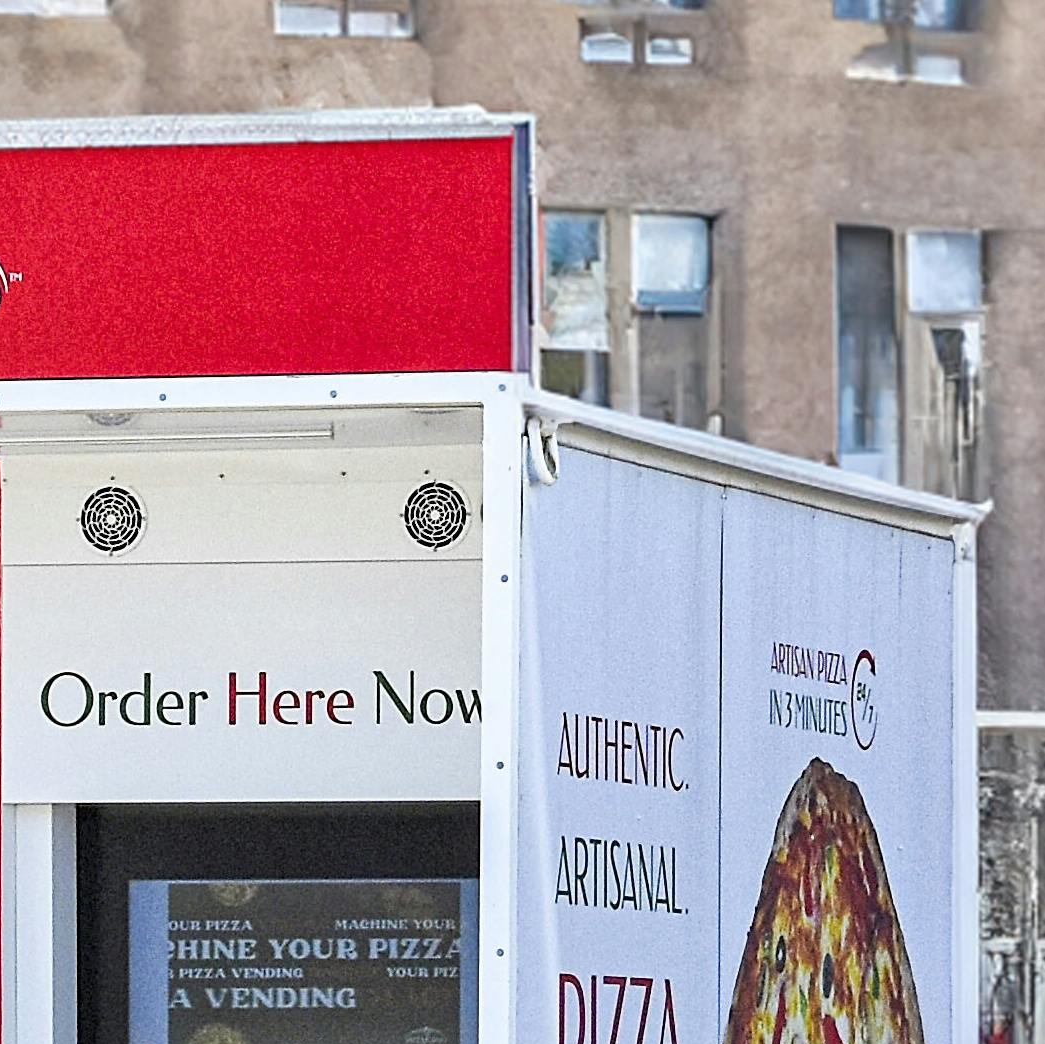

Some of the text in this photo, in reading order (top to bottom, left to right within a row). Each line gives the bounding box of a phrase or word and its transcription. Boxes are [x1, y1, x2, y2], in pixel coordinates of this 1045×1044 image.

[770, 641, 848, 685] ARTISAN PIZZA
[41, 671, 209, 727] Order
[228, 671, 355, 726] Here
[769, 689, 848, 737] IN 3 MINUTES
[557, 711, 689, 792] AUTHENTIC.
[554, 835, 689, 914] ARTISANAL.
[205, 920, 253, 931] PIZZA
[335, 919, 456, 930] MACHINE YOUR
[268, 938, 358, 960] YOUR
[179, 968, 226, 979] PIZZA
[231, 967, 304, 979] VENDING
[386, 967, 429, 978] YOUR
[204, 988, 356, 1009] VENDING
